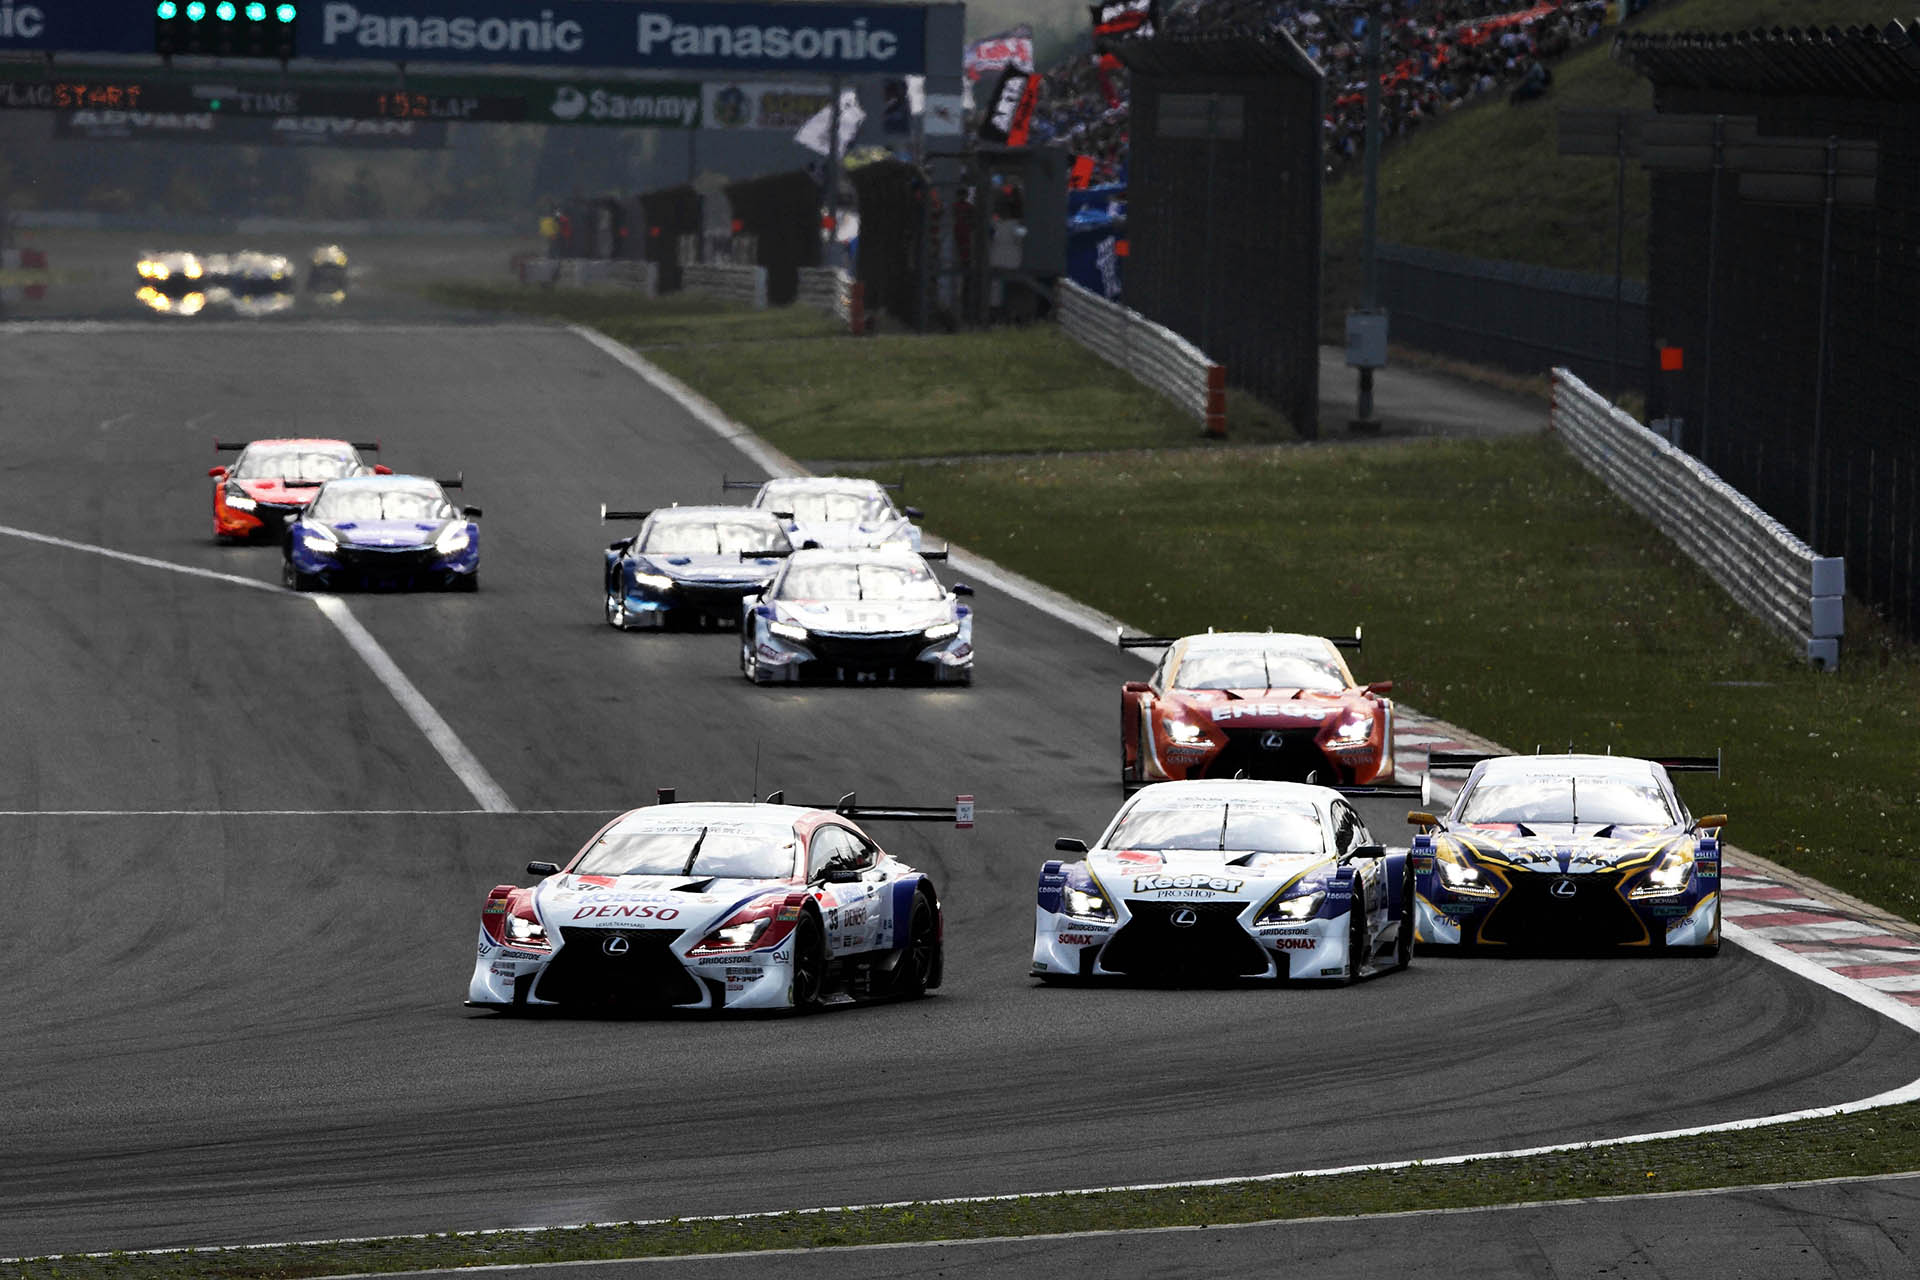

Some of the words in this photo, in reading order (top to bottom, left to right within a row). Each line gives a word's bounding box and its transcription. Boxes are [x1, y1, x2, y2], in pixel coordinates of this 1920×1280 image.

[322, 1, 583, 51] Panasonic
[636, 12, 898, 60] Panasonic
[54, 83, 143, 107] START
[588, 88, 698, 125] Sammy
[1133, 874, 1245, 894] KeePer
[1157, 889, 1182, 899] PRO
[1183, 889, 1216, 899] SHOP
[571, 904, 681, 921] DENSO
[843, 907, 868, 928] DENSO
[1058, 933, 1093, 945] SONAX
[1259, 927, 1310, 936] BRIDGESTONE
[1275, 938, 1317, 950] SONAX
[698, 955, 753, 966] BRIDGESTONE
